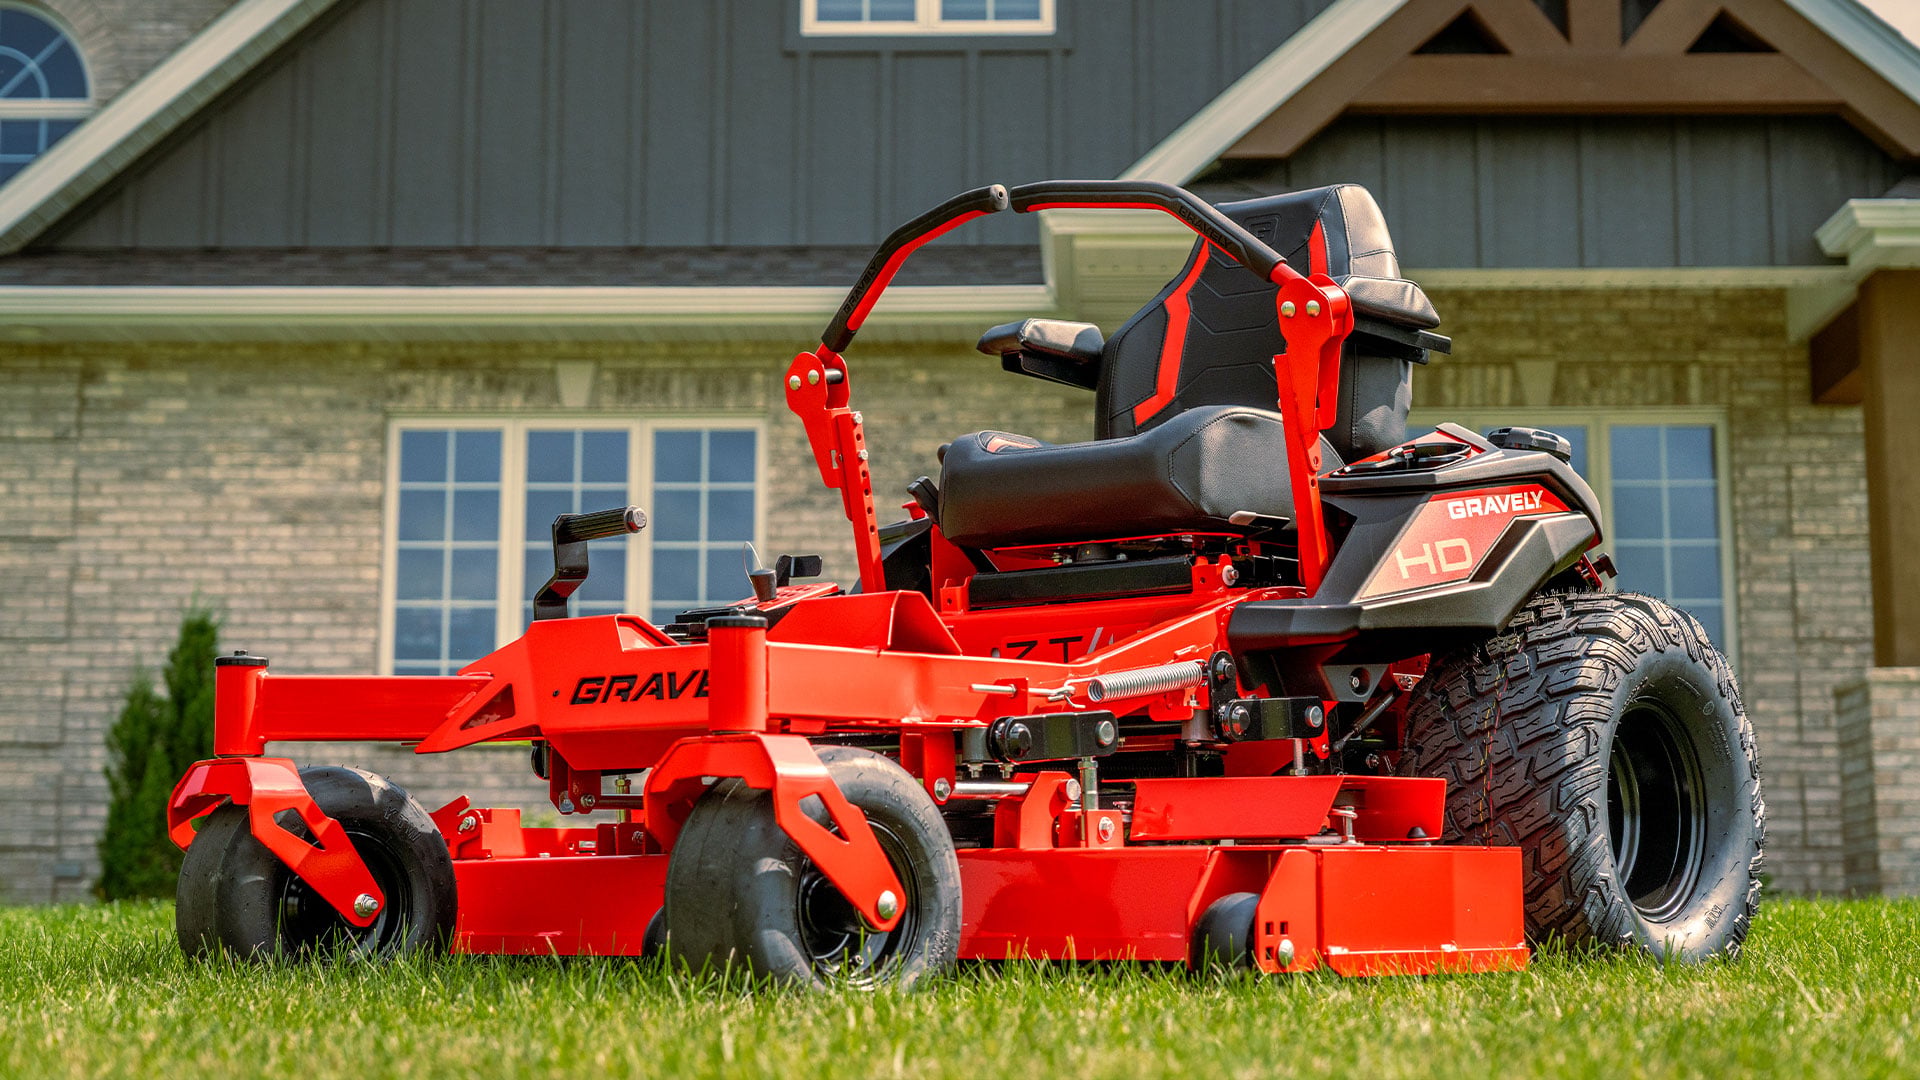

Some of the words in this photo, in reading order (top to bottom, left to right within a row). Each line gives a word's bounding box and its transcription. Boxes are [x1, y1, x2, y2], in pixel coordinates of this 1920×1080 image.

[1178, 206, 1228, 248] GRAVELY
[843, 261, 879, 314] GRAVELY
[1447, 490, 1543, 519] GRAVELY
[1395, 538, 1473, 579] HD
